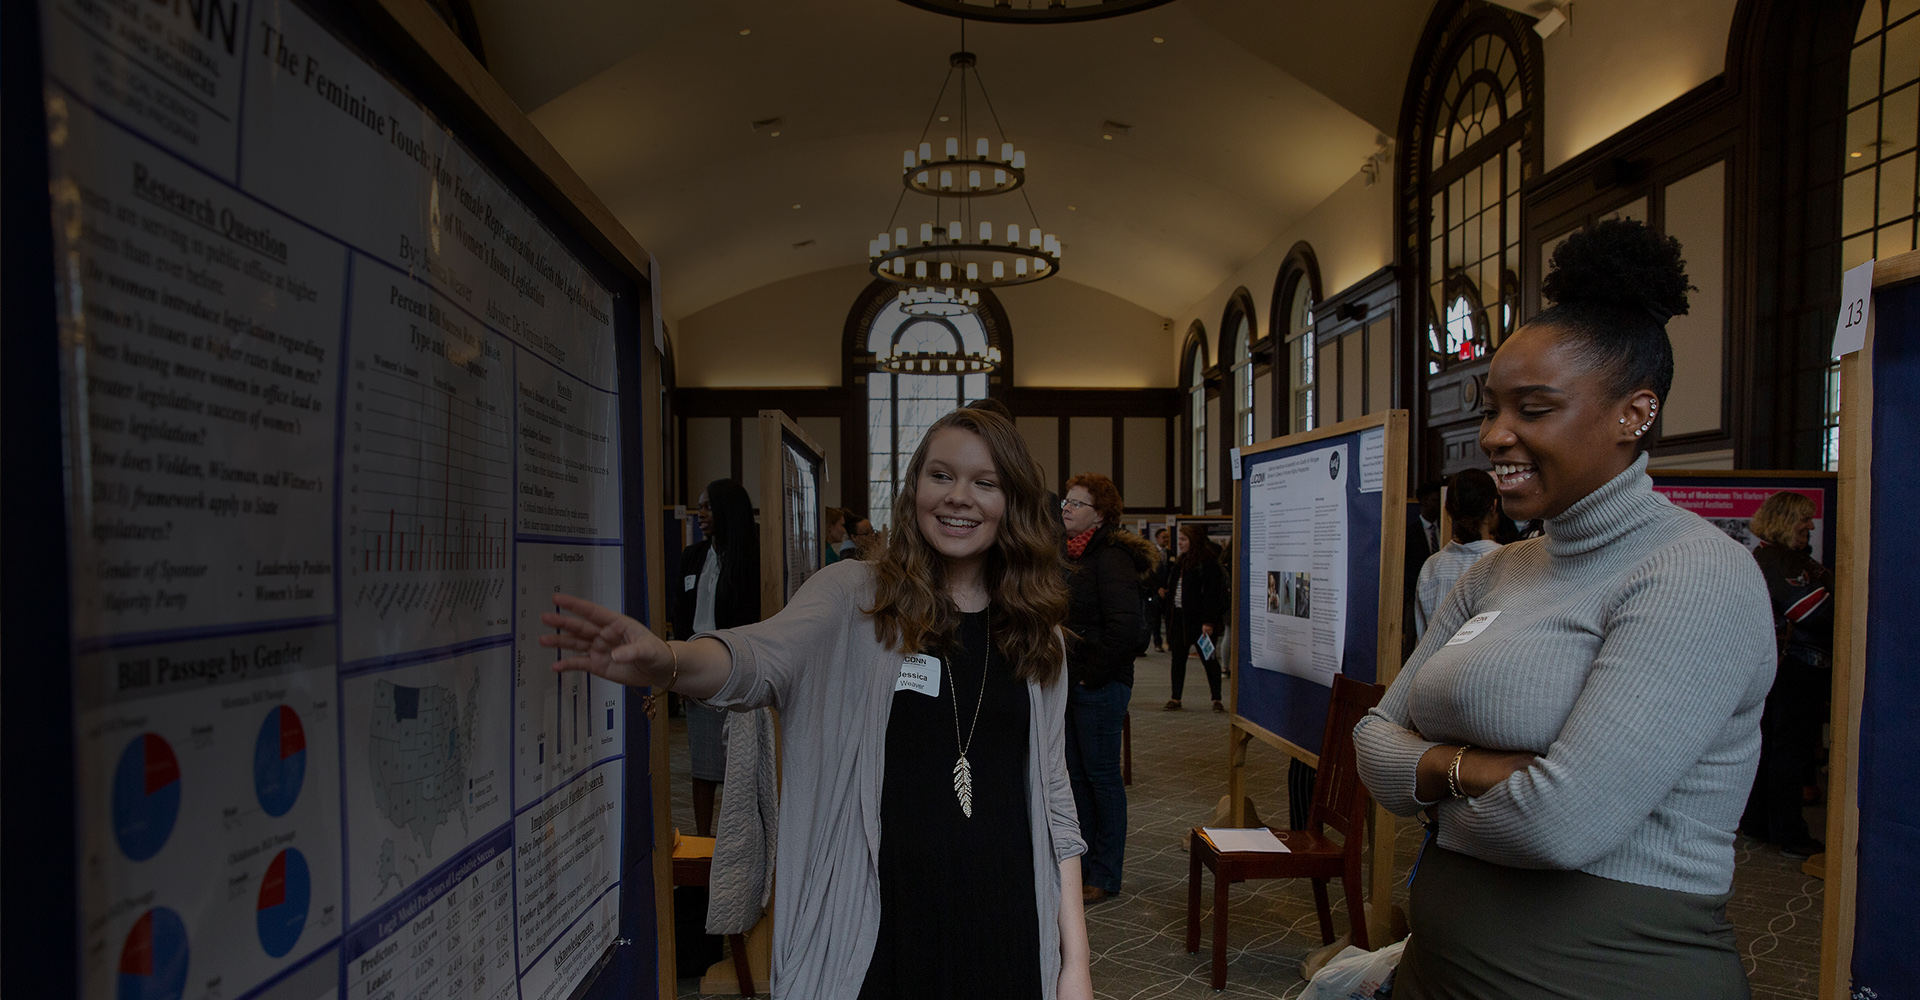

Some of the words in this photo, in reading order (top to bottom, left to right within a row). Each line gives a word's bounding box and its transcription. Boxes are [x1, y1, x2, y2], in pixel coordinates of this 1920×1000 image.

[261, 20, 299, 76] The
[303, 54, 386, 136] Feminine
[388, 115, 432, 172] Touch:
[455, 174, 484, 216] Female
[484, 204, 535, 267] Representation
[534, 254, 555, 284] Affects
[555, 268, 565, 291] the
[590, 298, 610, 327] Success
[132, 160, 217, 226] Research
[220, 207, 288, 259] Question
[399, 233, 421, 268] By:
[443, 213, 454, 234] of
[455, 216, 489, 265] Women's
[490, 248, 511, 283] Issues
[511, 265, 546, 309] Legislation
[206, 244, 241, 274] public
[242, 259, 273, 286] office
[286, 273, 319, 303] higher
[106, 271, 158, 303] women
[161, 284, 221, 324] introduce
[223, 308, 278, 343] legislation
[277, 332, 326, 365] regarding
[389, 284, 427, 320] Percent
[428, 303, 441, 328] Bill
[1845, 298, 1864, 328] 13
[409, 324, 432, 354] Type
[431, 336, 446, 358] and
[485, 298, 512, 331] Advisor:
[512, 314, 522, 336] Dr.
[522, 320, 543, 351] Virginia
[147, 315, 188, 348] issues
[270, 355, 294, 380] than
[373, 353, 403, 374] Women's
[121, 341, 171, 379] having
[173, 361, 206, 384] more
[209, 371, 250, 393] women
[262, 384, 290, 408] office
[290, 386, 311, 411] lead
[311, 396, 323, 414] to
[261, 470, 281, 489] and
[519, 481, 534, 496] Critical
[534, 484, 543, 498] Mass
[1672, 490, 1687, 499] Hole
[1687, 490, 1695, 500] of
[1696, 491, 1732, 500] Modernism:
[1733, 491, 1742, 500] The
[207, 492, 240, 519] apply
[253, 494, 280, 517] State
[1704, 500, 1734, 509] Aesthetics
[254, 559, 301, 580] Leadership
[254, 584, 293, 602] Women's
[117, 657, 151, 692] Bill
[155, 654, 227, 687] Passage
[229, 647, 249, 681] by
[252, 640, 304, 671] Gender
[898, 670, 928, 682] Jessica
[904, 656, 927, 665] CONN
[530, 802, 560, 831] Implications
[560, 794, 569, 811] and
[569, 787, 584, 804] Further
[584, 772, 605, 794] Research
[518, 840, 532, 859] Policy
[417, 882, 446, 911] Predictors
[451, 859, 478, 884] Legislative
[477, 846, 496, 865] Success
[359, 939, 399, 976] Predictors
[412, 909, 436, 937] Overall
[447, 891, 458, 909] MT
[472, 874, 480, 889] IN
[495, 857, 505, 872] OK
[519, 906, 537, 928] Further
[553, 919, 595, 970] Acknowledgements
[366, 968, 394, 996] Leader
